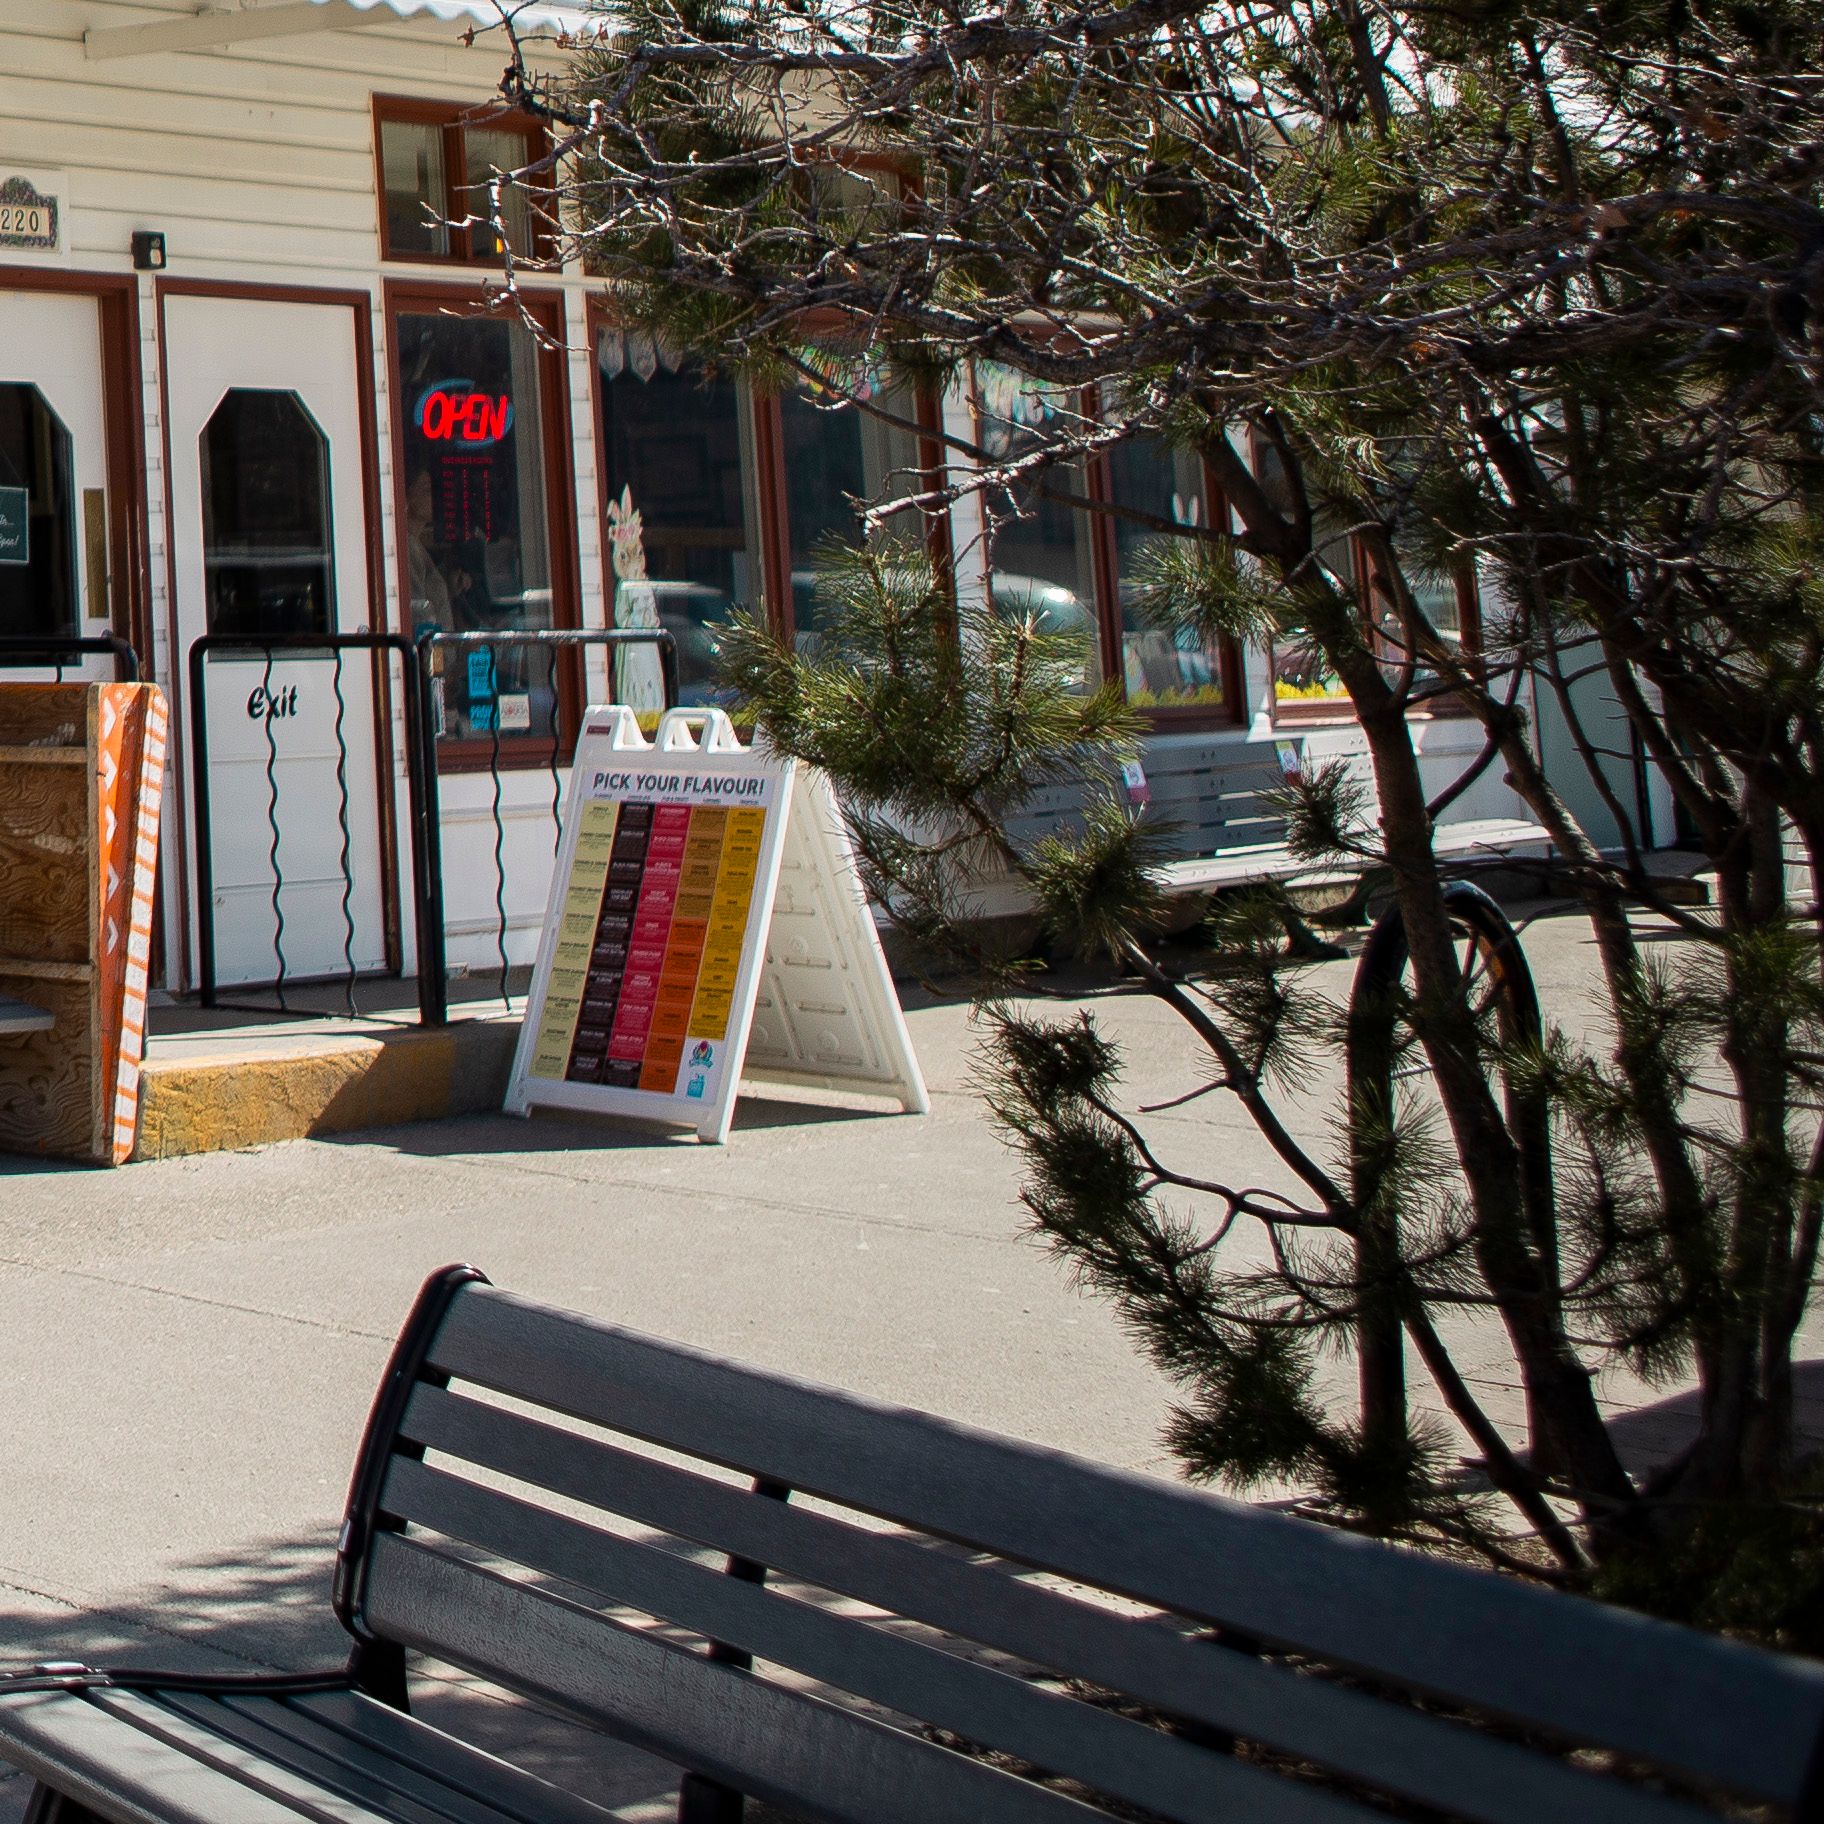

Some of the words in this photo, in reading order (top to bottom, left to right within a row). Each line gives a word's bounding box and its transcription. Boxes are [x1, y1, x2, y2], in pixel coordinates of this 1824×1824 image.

[0, 208, 40, 233] 220
[422, 390, 509, 441] OPEN
[592, 772, 632, 792] PICK
[636, 774, 681, 794] YOUR
[682, 776, 766, 796] FLAVOUR!
